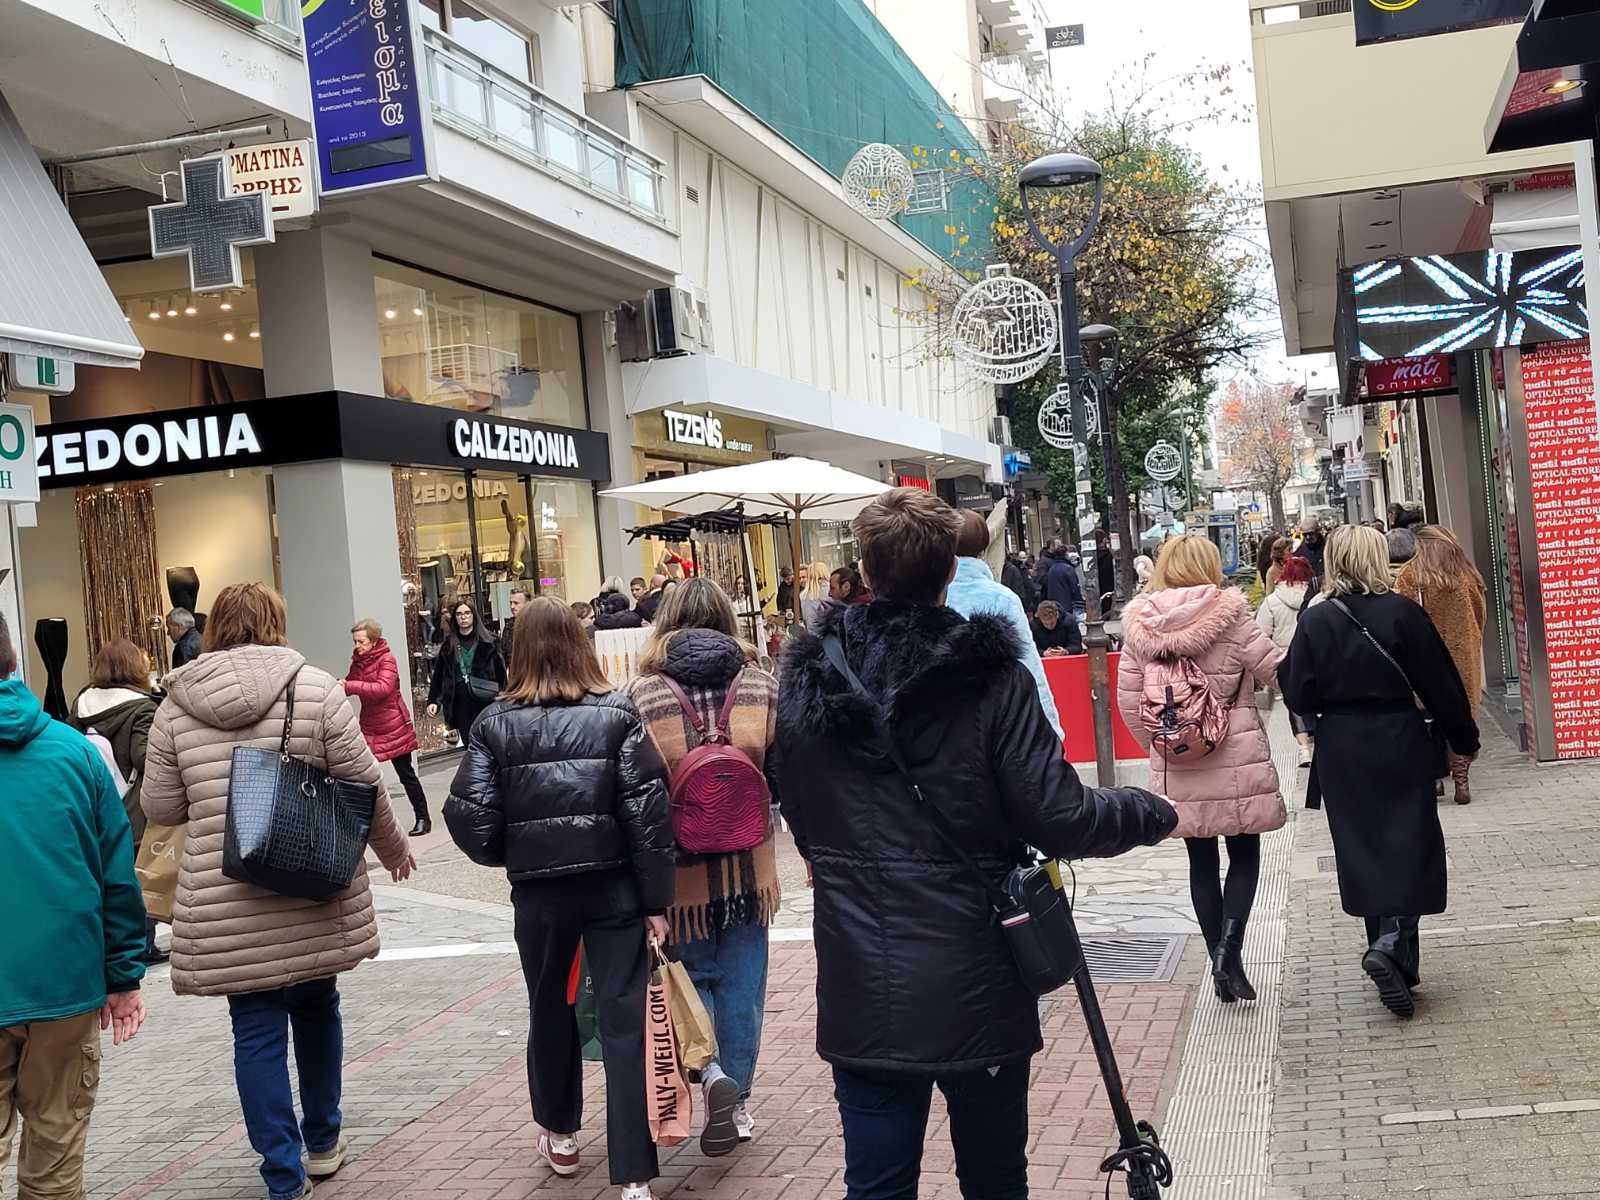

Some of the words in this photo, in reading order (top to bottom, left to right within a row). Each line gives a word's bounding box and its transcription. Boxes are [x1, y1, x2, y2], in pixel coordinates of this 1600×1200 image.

[1525, 388, 1562, 399] OPTICAL
[1529, 428, 1567, 439] OPTICAL
[454, 418, 579, 468] CALZEDONIA
[1532, 469, 1570, 479] OPTICAL
[1536, 509, 1574, 519] OPTICAL
[1540, 549, 1578, 559] OPTICAL
[1543, 589, 1582, 599] OPTICAL
[1547, 629, 1586, 639] OPTICAL
[1551, 669, 1590, 679] OPTICAL
[1555, 709, 1593, 719] OPTICAL
[1559, 749, 1598, 759] OPTICAL
